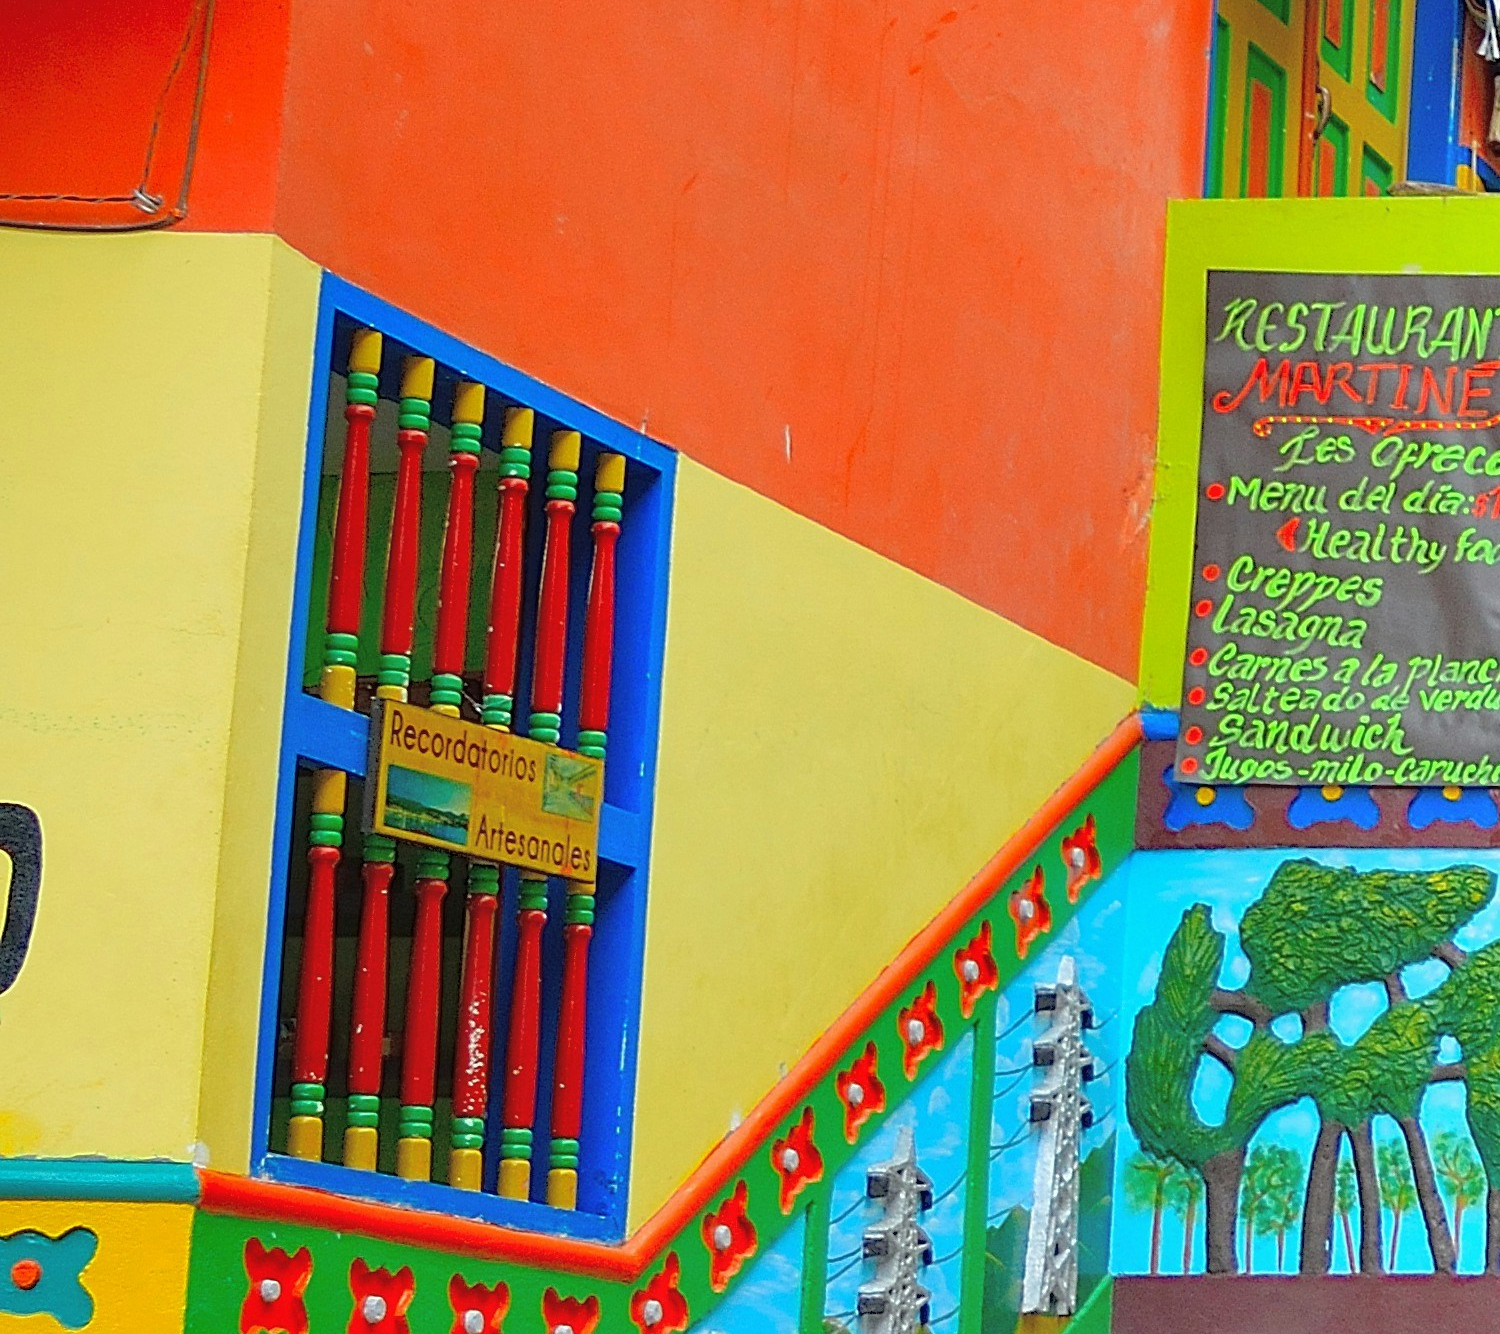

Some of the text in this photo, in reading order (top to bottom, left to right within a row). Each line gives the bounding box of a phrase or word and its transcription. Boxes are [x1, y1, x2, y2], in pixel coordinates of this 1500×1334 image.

[1272, 424, 1357, 473] Les
[1227, 475, 1327, 514] Menu
[1338, 475, 1396, 515] del
[1299, 517, 1448, 575] Healthy
[1226, 555, 1384, 613] Creppes
[1210, 593, 1368, 656] Lasagna
[1208, 642, 1329, 684] Carnes
[1333, 656, 1361, 685] a
[1360, 652, 1399, 689] la
[1205, 681, 1366, 716] Salteado
[1370, 684, 1411, 712] de
[390, 709, 537, 783] Recordatorios
[1208, 712, 1415, 756] Sandwich
[475, 813, 591, 873] Artesanales
